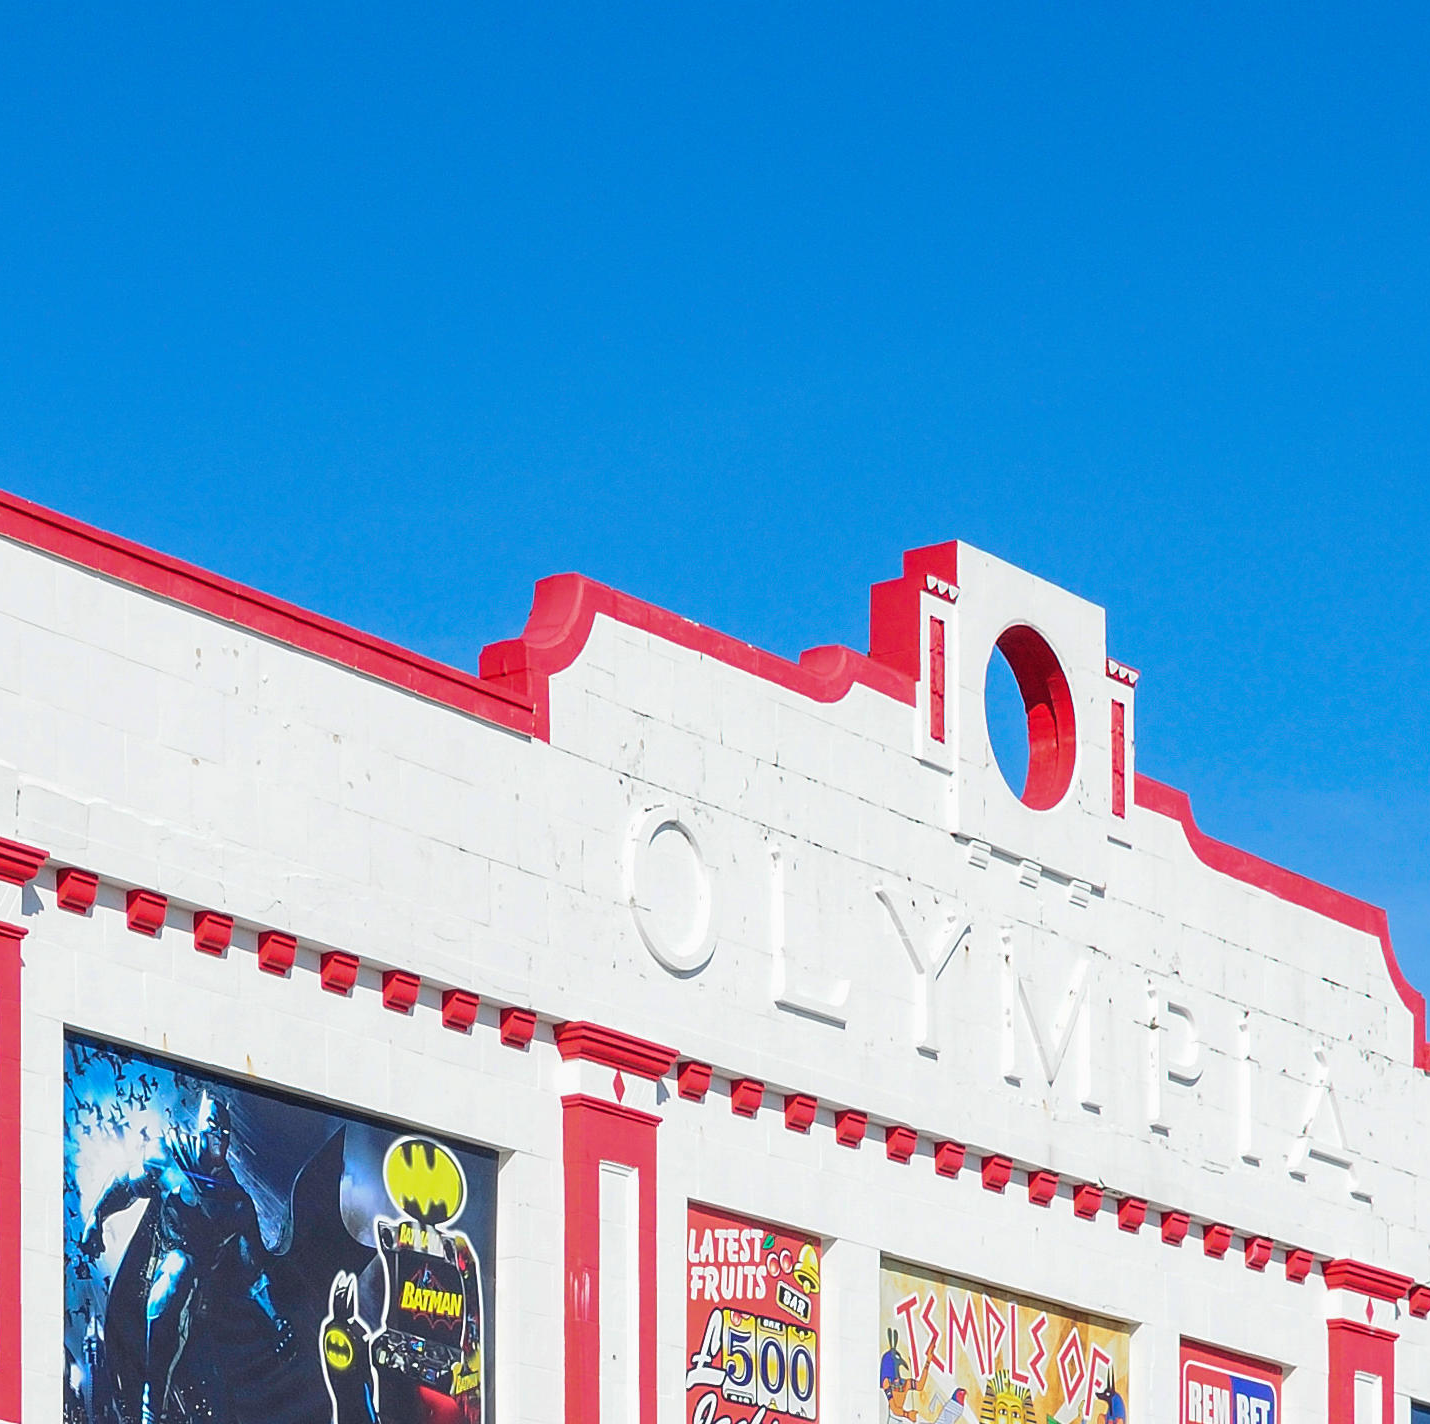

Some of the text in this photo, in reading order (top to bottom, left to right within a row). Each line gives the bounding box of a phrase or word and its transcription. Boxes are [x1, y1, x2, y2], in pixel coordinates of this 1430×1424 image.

[622, 804, 1371, 1202] OLYMPIA
[688, 1228, 765, 1264] LATEST
[401, 1281, 463, 1318] BATMAN
[690, 1265, 767, 1303] FRUITS
[782, 1289, 807, 1318] BAR
[896, 1294, 1111, 1416] TEMPLE OF
